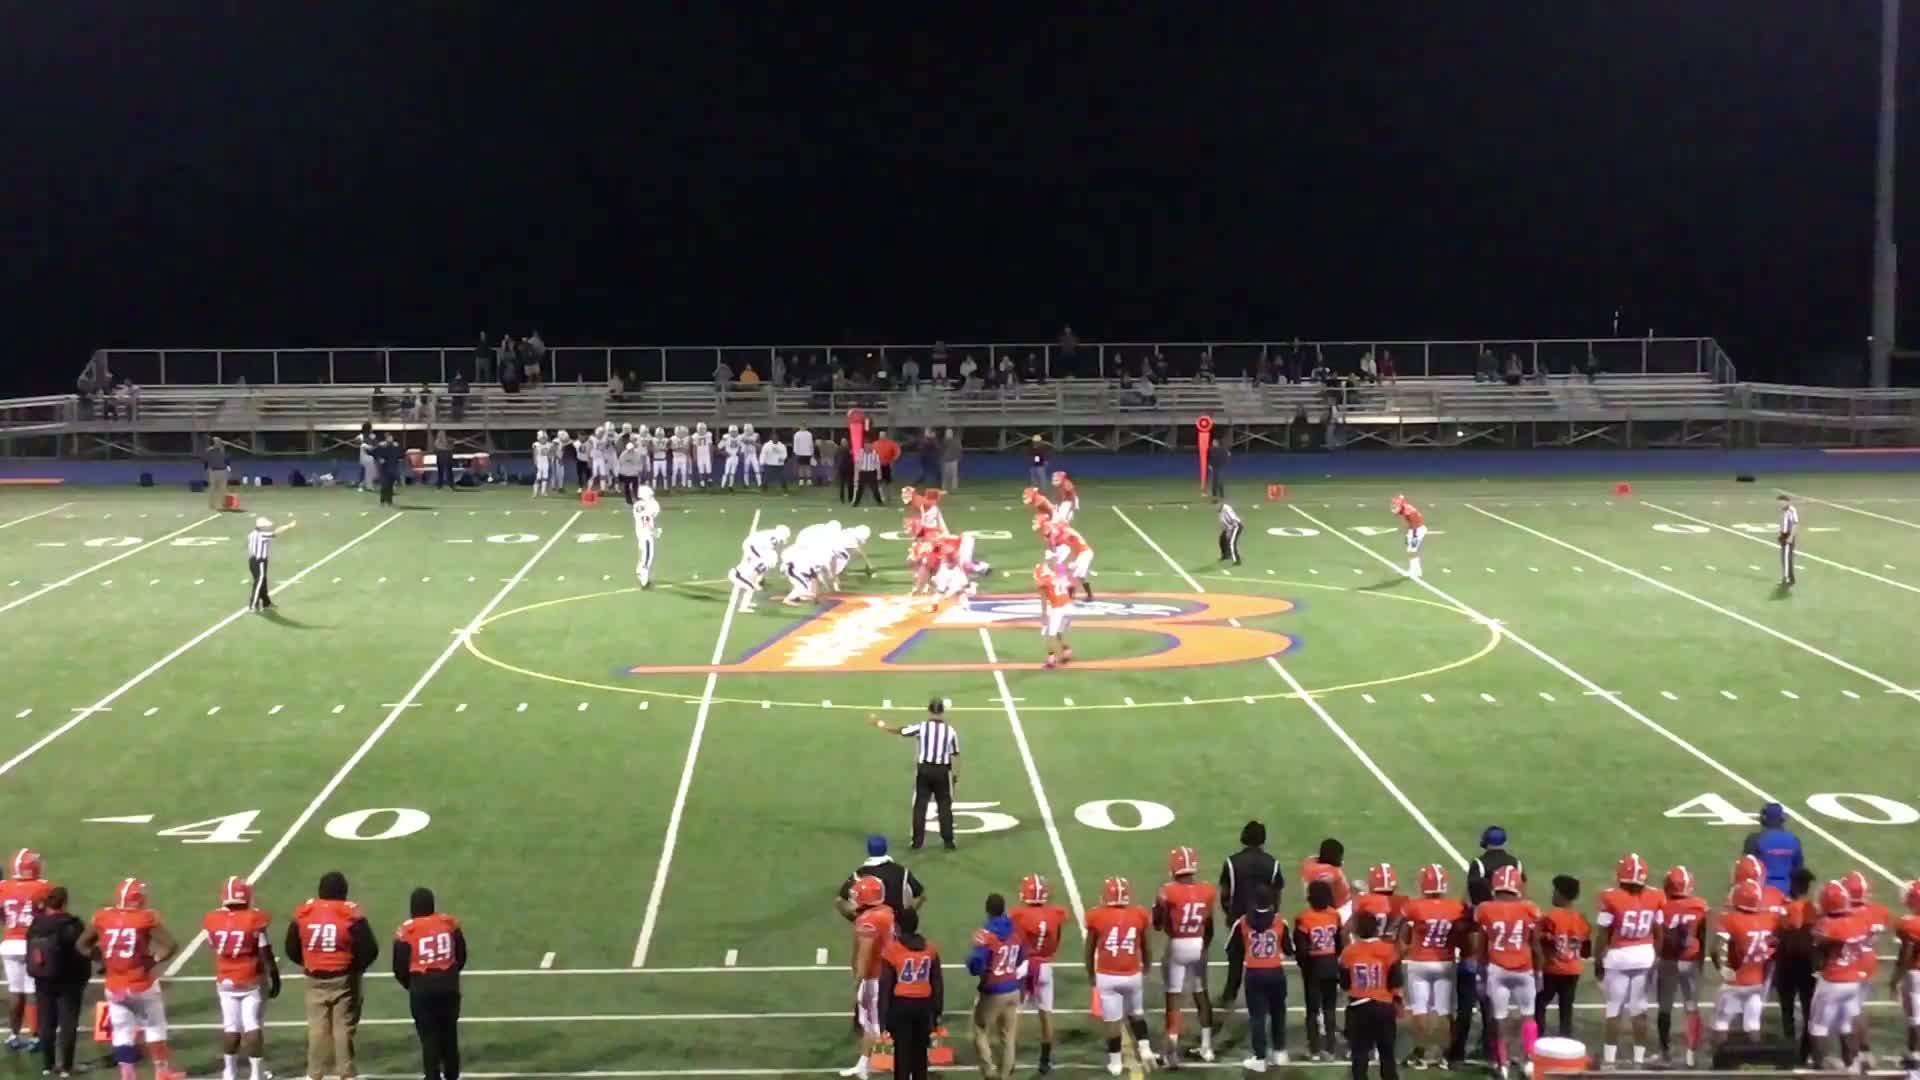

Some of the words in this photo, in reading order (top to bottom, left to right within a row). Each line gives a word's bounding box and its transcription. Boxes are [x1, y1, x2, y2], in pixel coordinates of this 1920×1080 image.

[1179, 902, 1206, 933] 15
[1620, 910, 1652, 938] 68
[104, 927, 137, 958] 73
[213, 930, 244, 959] 77
[307, 924, 337, 952] 78
[1036, 920, 1047, 950] 1
[1103, 927, 1137, 956] 44
[1492, 919, 1524, 951] 24
[898, 955, 931, 983] 44
